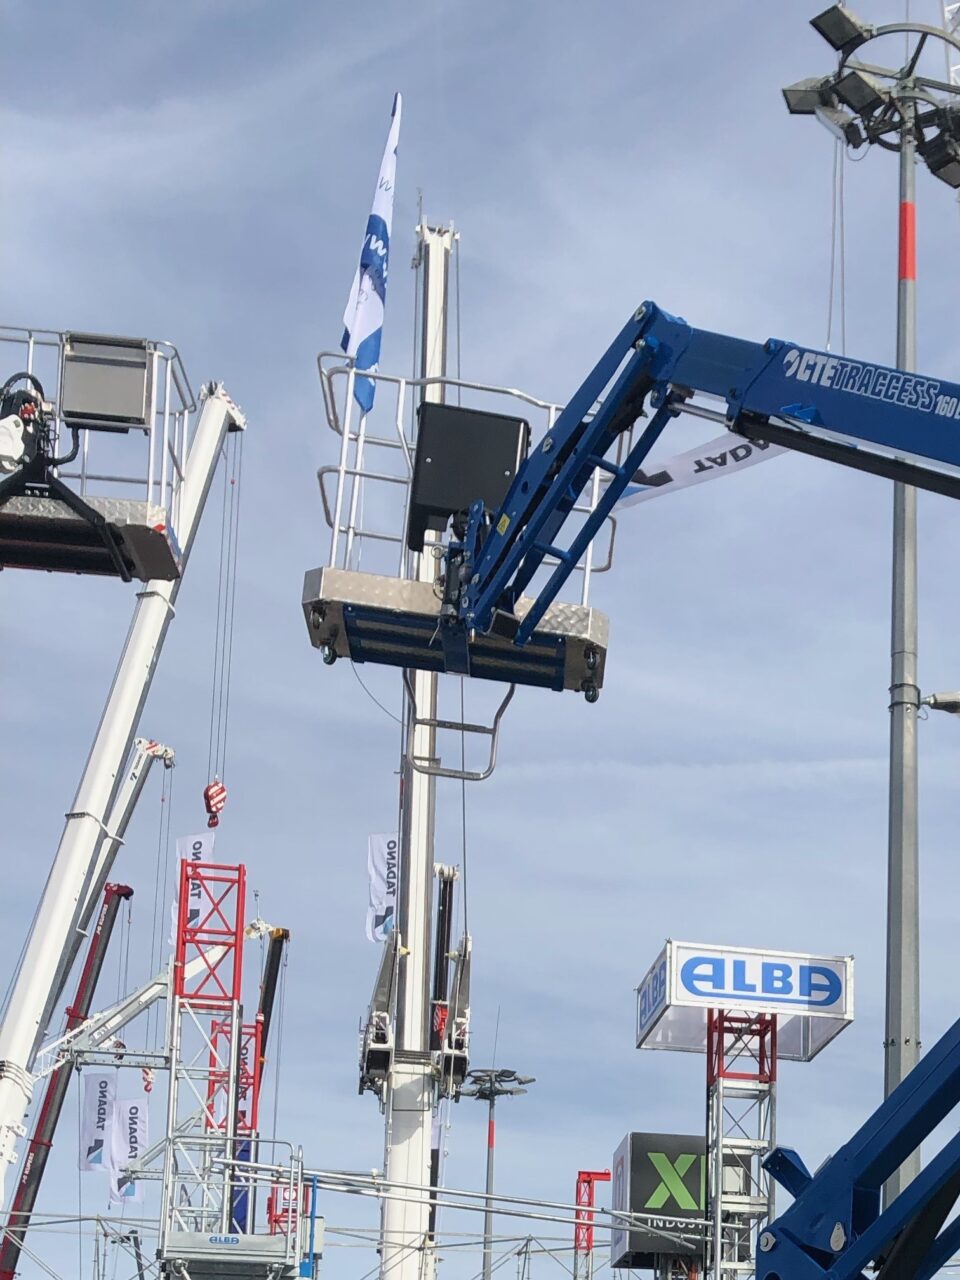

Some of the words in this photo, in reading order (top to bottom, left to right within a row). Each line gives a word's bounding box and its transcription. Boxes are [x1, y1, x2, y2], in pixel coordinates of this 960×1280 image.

[833, 360, 940, 412] TRACCESS
[639, 960, 667, 1031] ALBA
[680, 956, 842, 1007] ALBA
